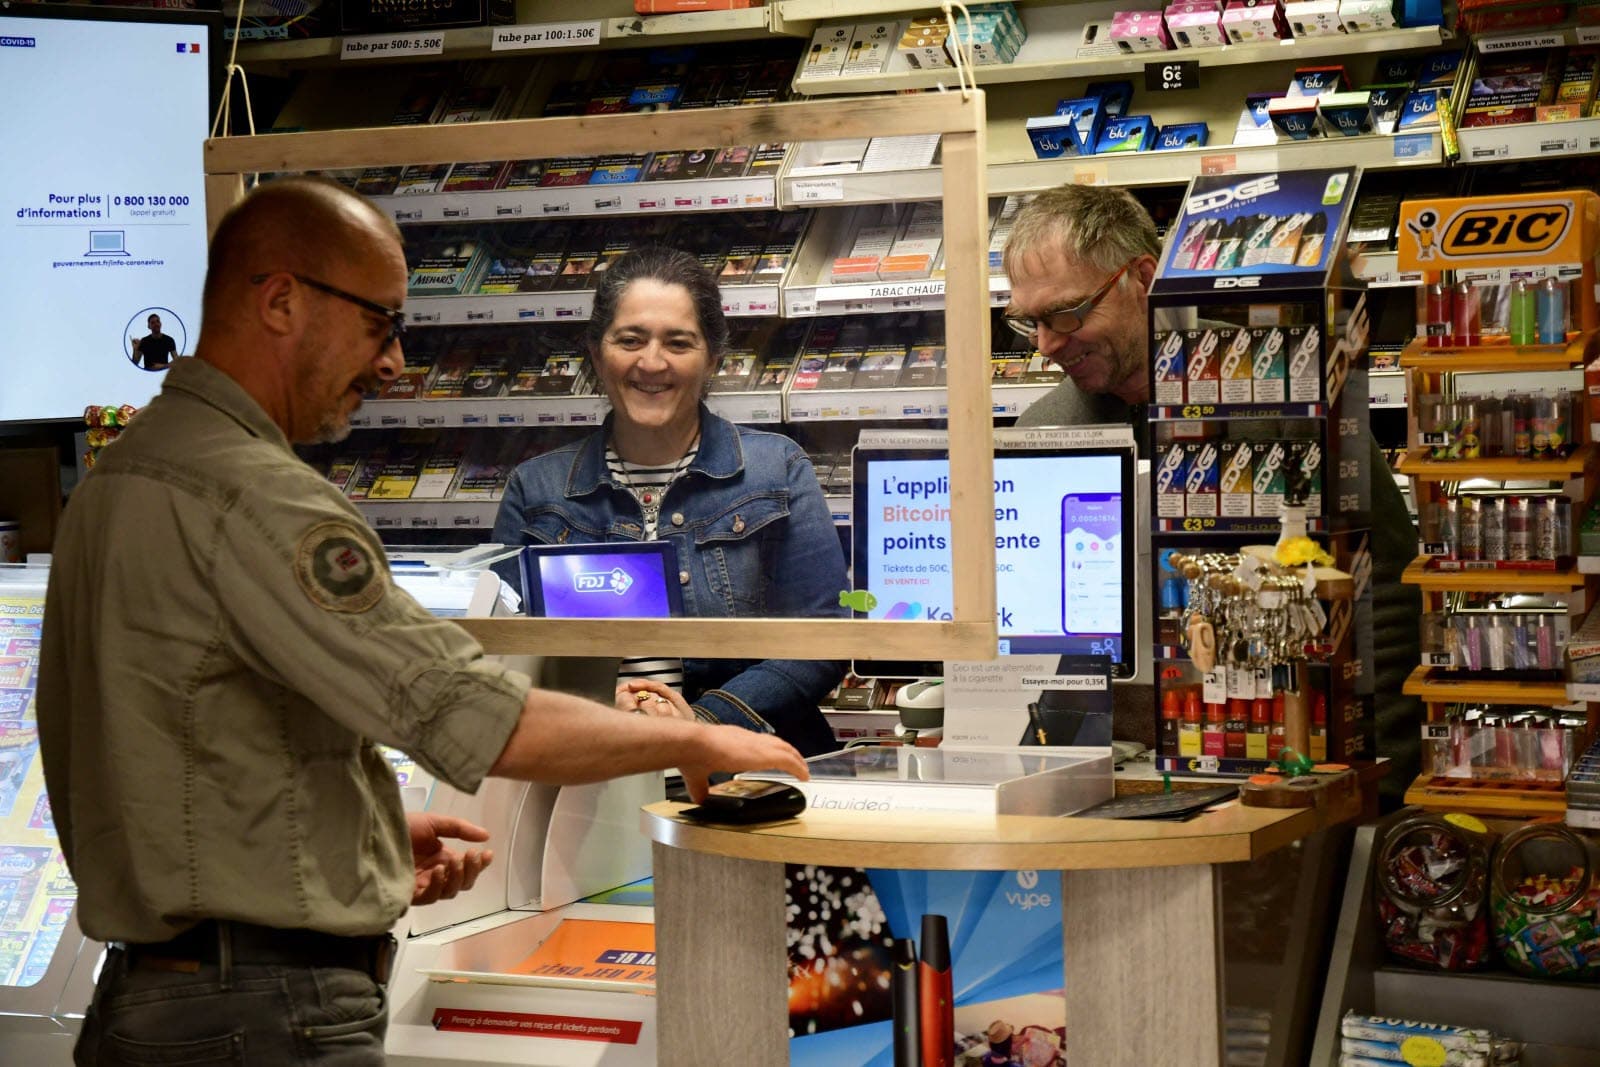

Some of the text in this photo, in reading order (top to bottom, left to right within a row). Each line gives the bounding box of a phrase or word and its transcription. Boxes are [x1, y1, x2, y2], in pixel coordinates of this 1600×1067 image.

[0, 38, 34, 46] COVID-19
[498, 33, 521, 43] tube
[523, 34, 543, 43] par
[346, 38, 441, 53] tube par 500: 5.50€
[1486, 40, 1531, 49] CHARBON
[1388, 66, 1407, 77] blu
[1432, 60, 1452, 72] blu
[1304, 78, 1323, 89] blu
[1256, 105, 1269, 115] bl
[1413, 101, 1433, 113] blu
[1286, 121, 1306, 132] blu
[1338, 116, 1358, 128] blu
[1109, 128, 1128, 139] blu
[1039, 139, 1059, 151] blu
[1164, 134, 1183, 147] blu
[49, 193, 102, 206] Pour plus
[114, 196, 190, 206] 0 800 130 000
[1186, 174, 1280, 216] EDGE
[16, 207, 102, 219] d'informations
[52, 259, 165, 269] gouvernement.fr/info-coronavirus
[1214, 276, 1262, 289] EDGE
[870, 284, 945, 297] TABAC CHAUF
[1183, 405, 1215, 419] €3 50
[1003, 441, 1027, 449] MERCI
[1028, 440, 1037, 448] DE
[1039, 440, 1064, 448] VOTRE
[883, 505, 951, 523] Bitcoin
[1183, 518, 1203, 531] €3
[883, 532, 1041, 555] points ente
[883, 564, 913, 573] Tickets
[915, 564, 928, 573] de
[929, 564, 950, 575] 50€,
[578, 577, 605, 589] FDJ
[952, 664, 1044, 673] Ceci est une alternative
[952, 675, 1003, 684] à la cigarette
[1022, 677, 1104, 687] Essayez-moi pour 0,35€
[1005, 891, 1051, 911] vype
[452, 1016, 475, 1027] Pensez
[476, 1017, 482, 1025] à
[482, 1017, 520, 1028] demander
[519, 1021, 534, 1029] vos
[553, 1022, 561, 1030] et
[562, 1022, 587, 1033] tickets
[587, 1024, 621, 1036] perdants
